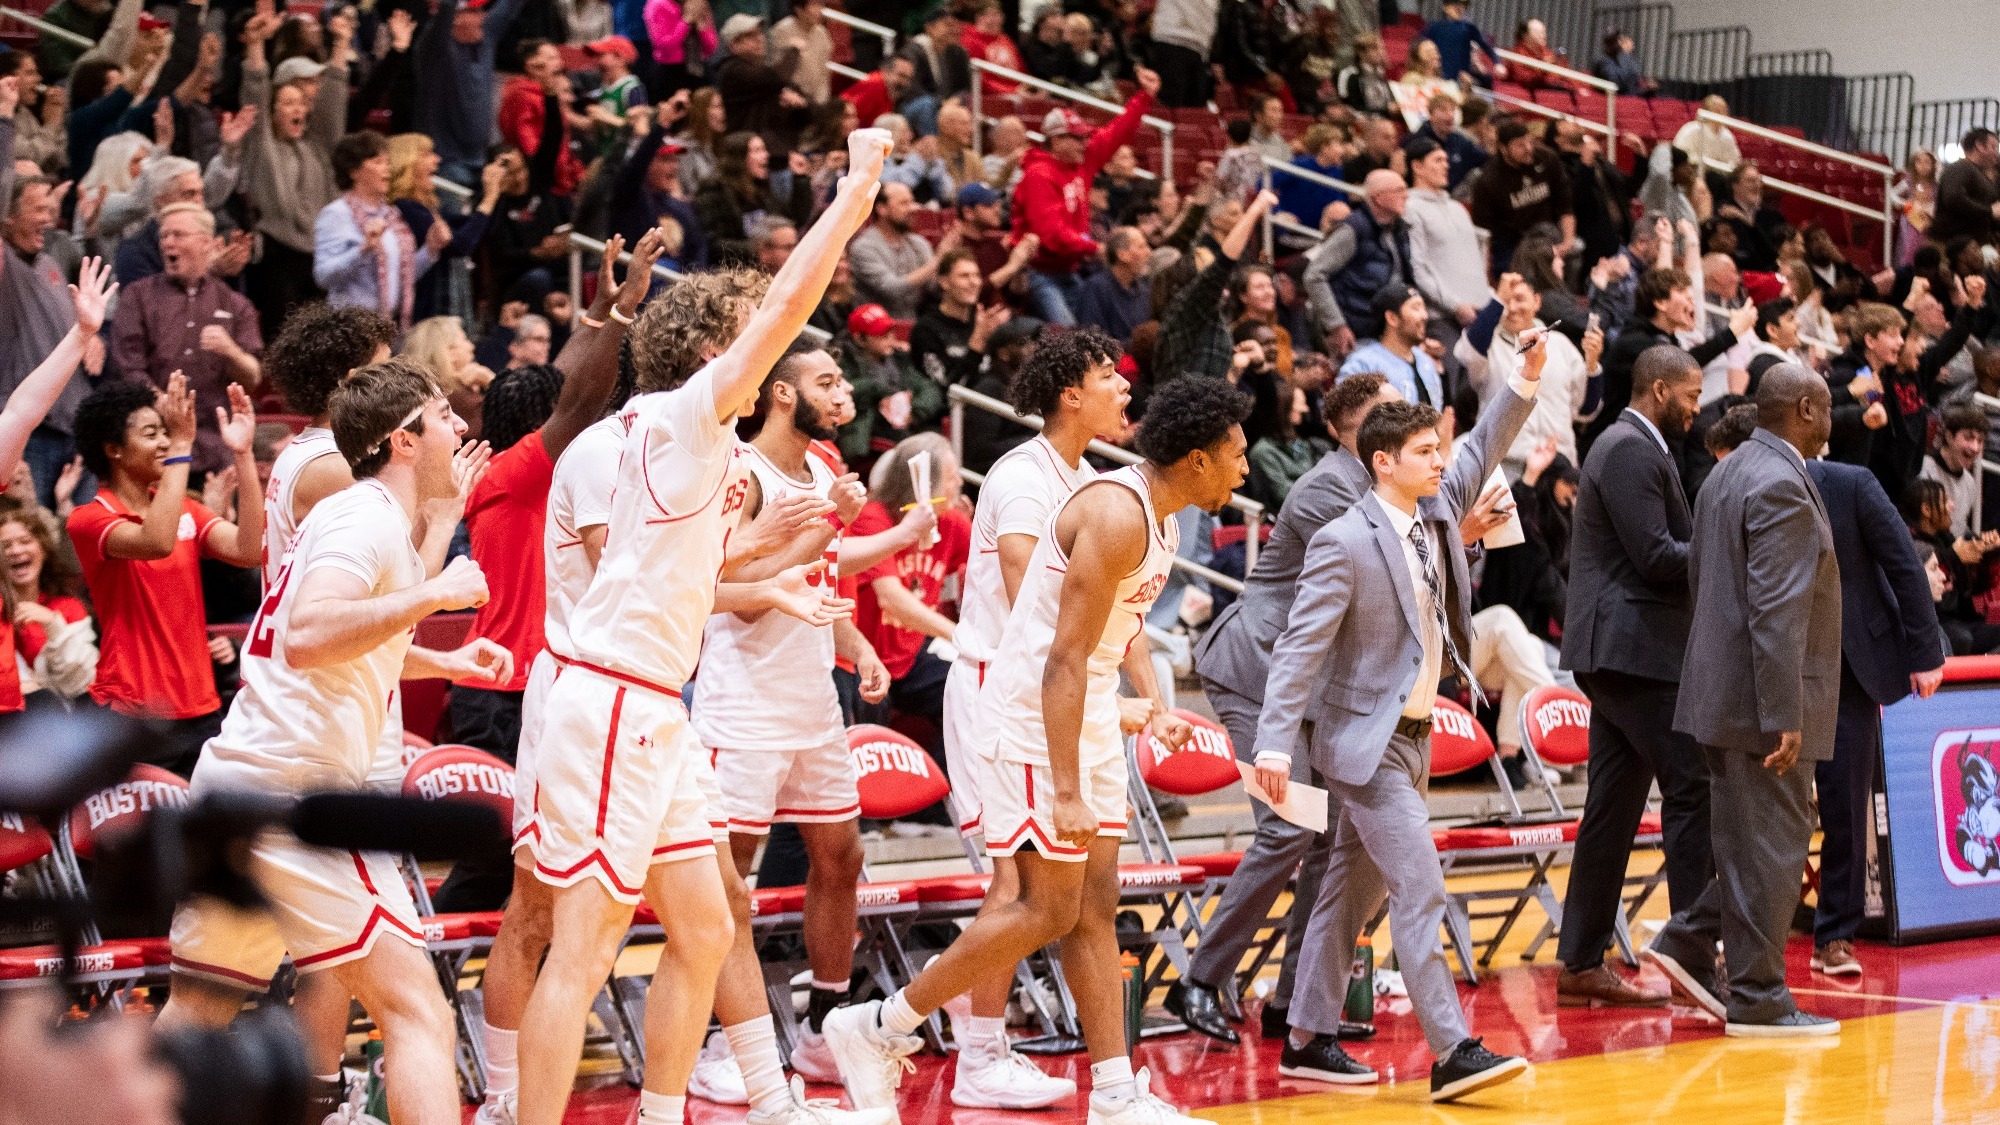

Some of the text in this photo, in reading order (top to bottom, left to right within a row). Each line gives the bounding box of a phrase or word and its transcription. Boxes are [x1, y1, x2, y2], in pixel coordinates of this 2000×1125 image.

[1432, 706, 1476, 741] TON
[851, 741, 930, 778] OSTON
[1510, 827, 1563, 846] TERRIERS
